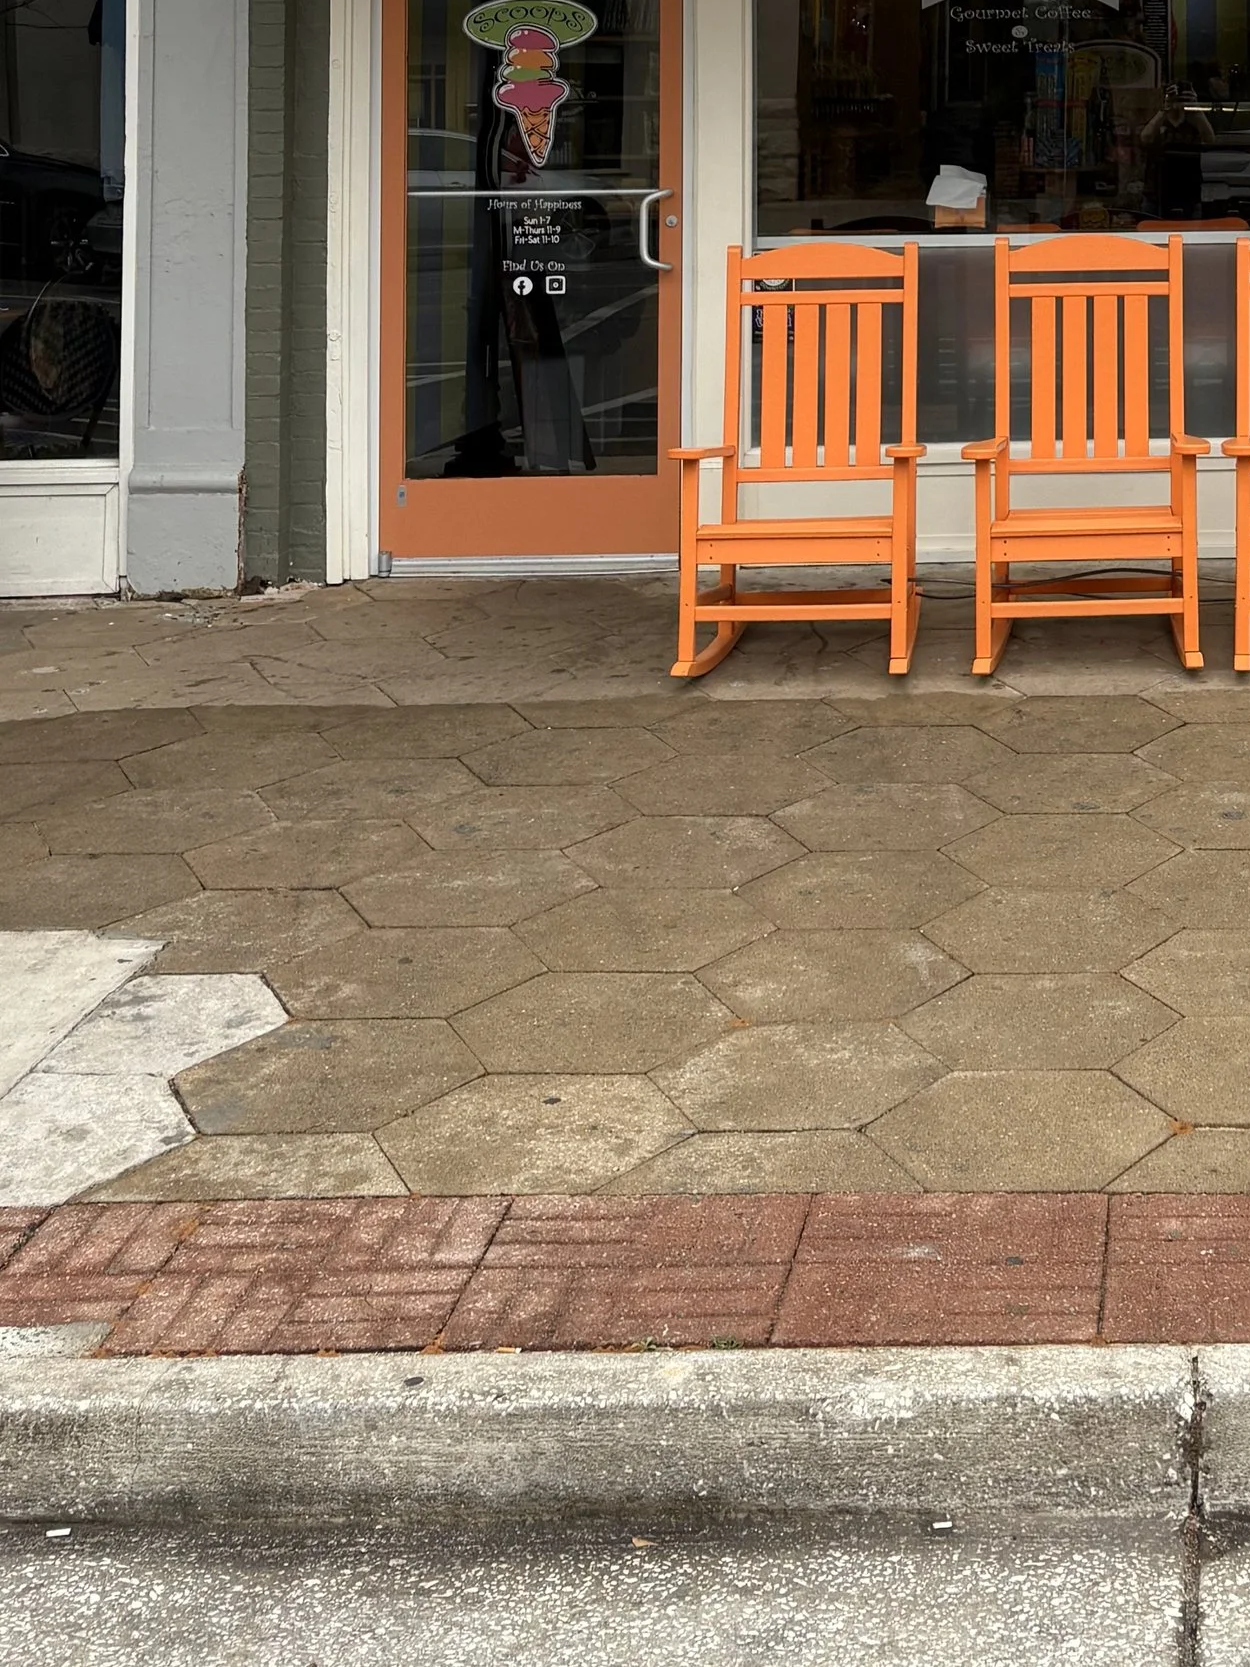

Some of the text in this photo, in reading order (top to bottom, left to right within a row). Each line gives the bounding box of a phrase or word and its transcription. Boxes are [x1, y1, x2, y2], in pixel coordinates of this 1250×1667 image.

[949, 5, 1093, 23] Gourmet Coffee
[965, 37, 1076, 55] Sweet Treats
[487, 198, 582, 212] Hours of Happiness
[523, 215, 552, 226] Sun 1-7
[513, 225, 561, 235] M-Thurs 11-9
[514, 235, 560, 245] Fri-Sat 11-10
[502, 259, 566, 272] Find Us On
